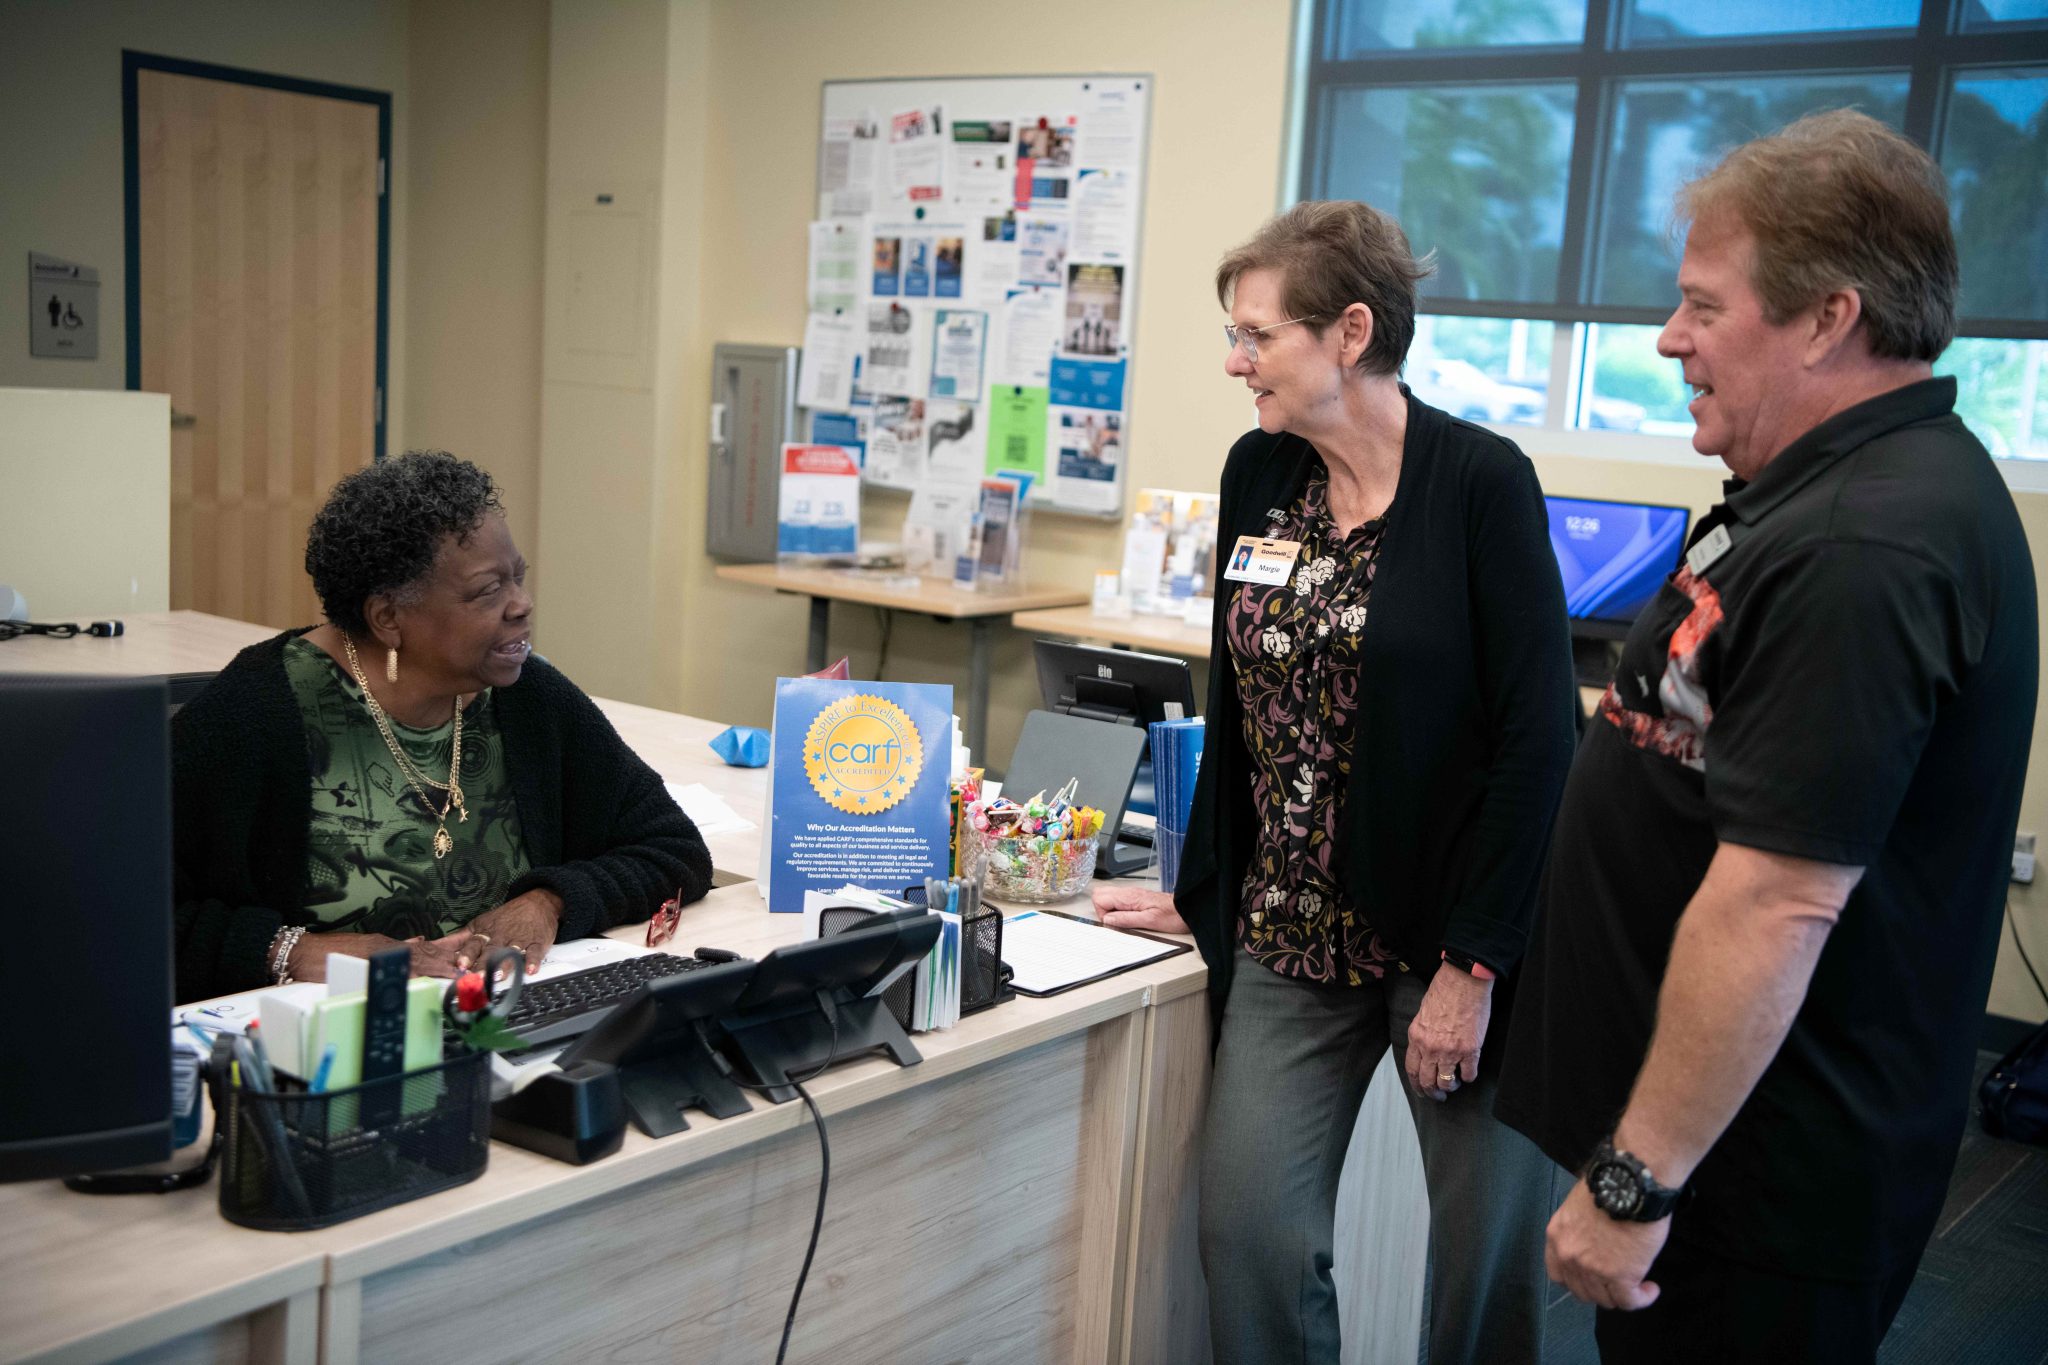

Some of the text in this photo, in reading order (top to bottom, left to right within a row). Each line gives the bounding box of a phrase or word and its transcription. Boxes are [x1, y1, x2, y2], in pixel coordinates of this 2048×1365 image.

[1258, 565, 1280, 573] Margie
[814, 701, 911, 748] ASPIRE to Excellence
[829, 738, 900, 764] carf
[835, 768, 891, 776] ACCREDITED
[807, 823, 824, 832] Why
